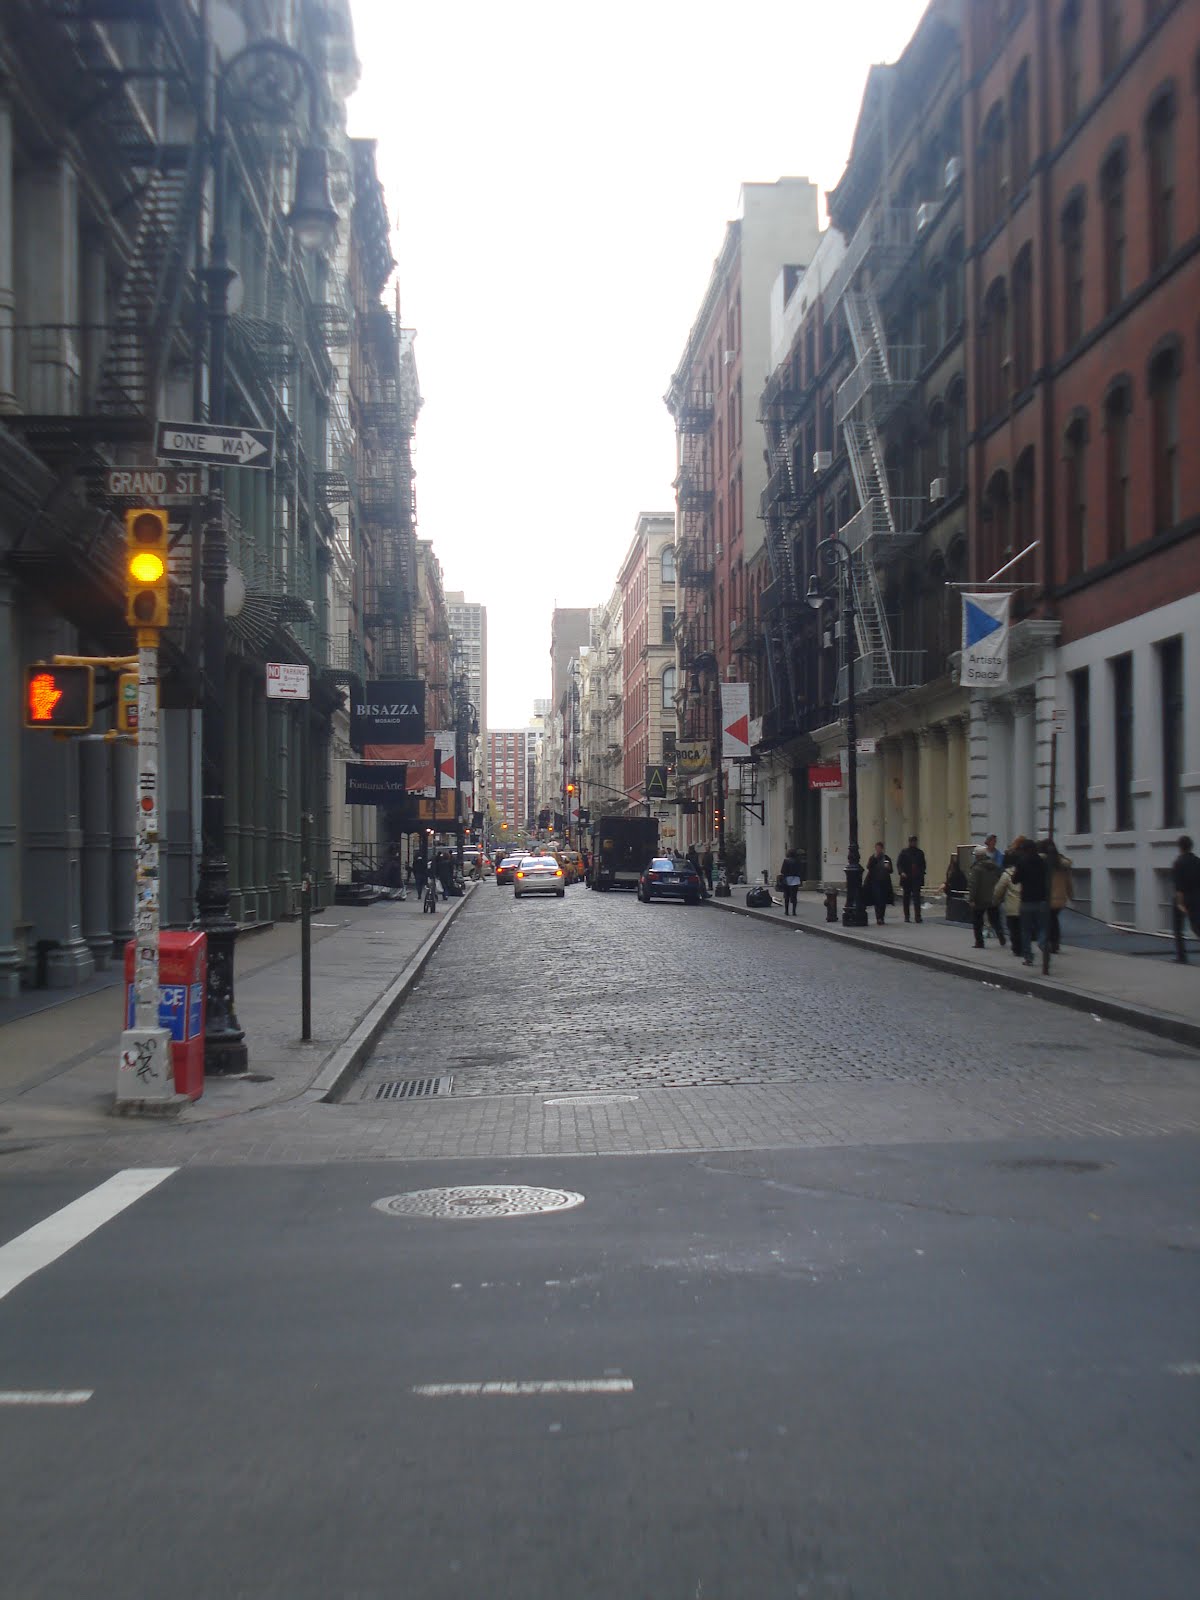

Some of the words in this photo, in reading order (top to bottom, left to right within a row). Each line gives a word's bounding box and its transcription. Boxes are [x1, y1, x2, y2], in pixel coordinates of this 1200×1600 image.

[173, 434, 207, 451] ONE
[222, 439, 257, 455] WAY
[109, 472, 167, 494] GRAND
[176, 472, 198, 494] ST
[969, 655, 1002, 665] Artists
[268, 665, 280, 677] NO
[968, 668, 999, 680] Space
[356, 704, 419, 716] BISAZZA
[648, 769, 665, 791] A
